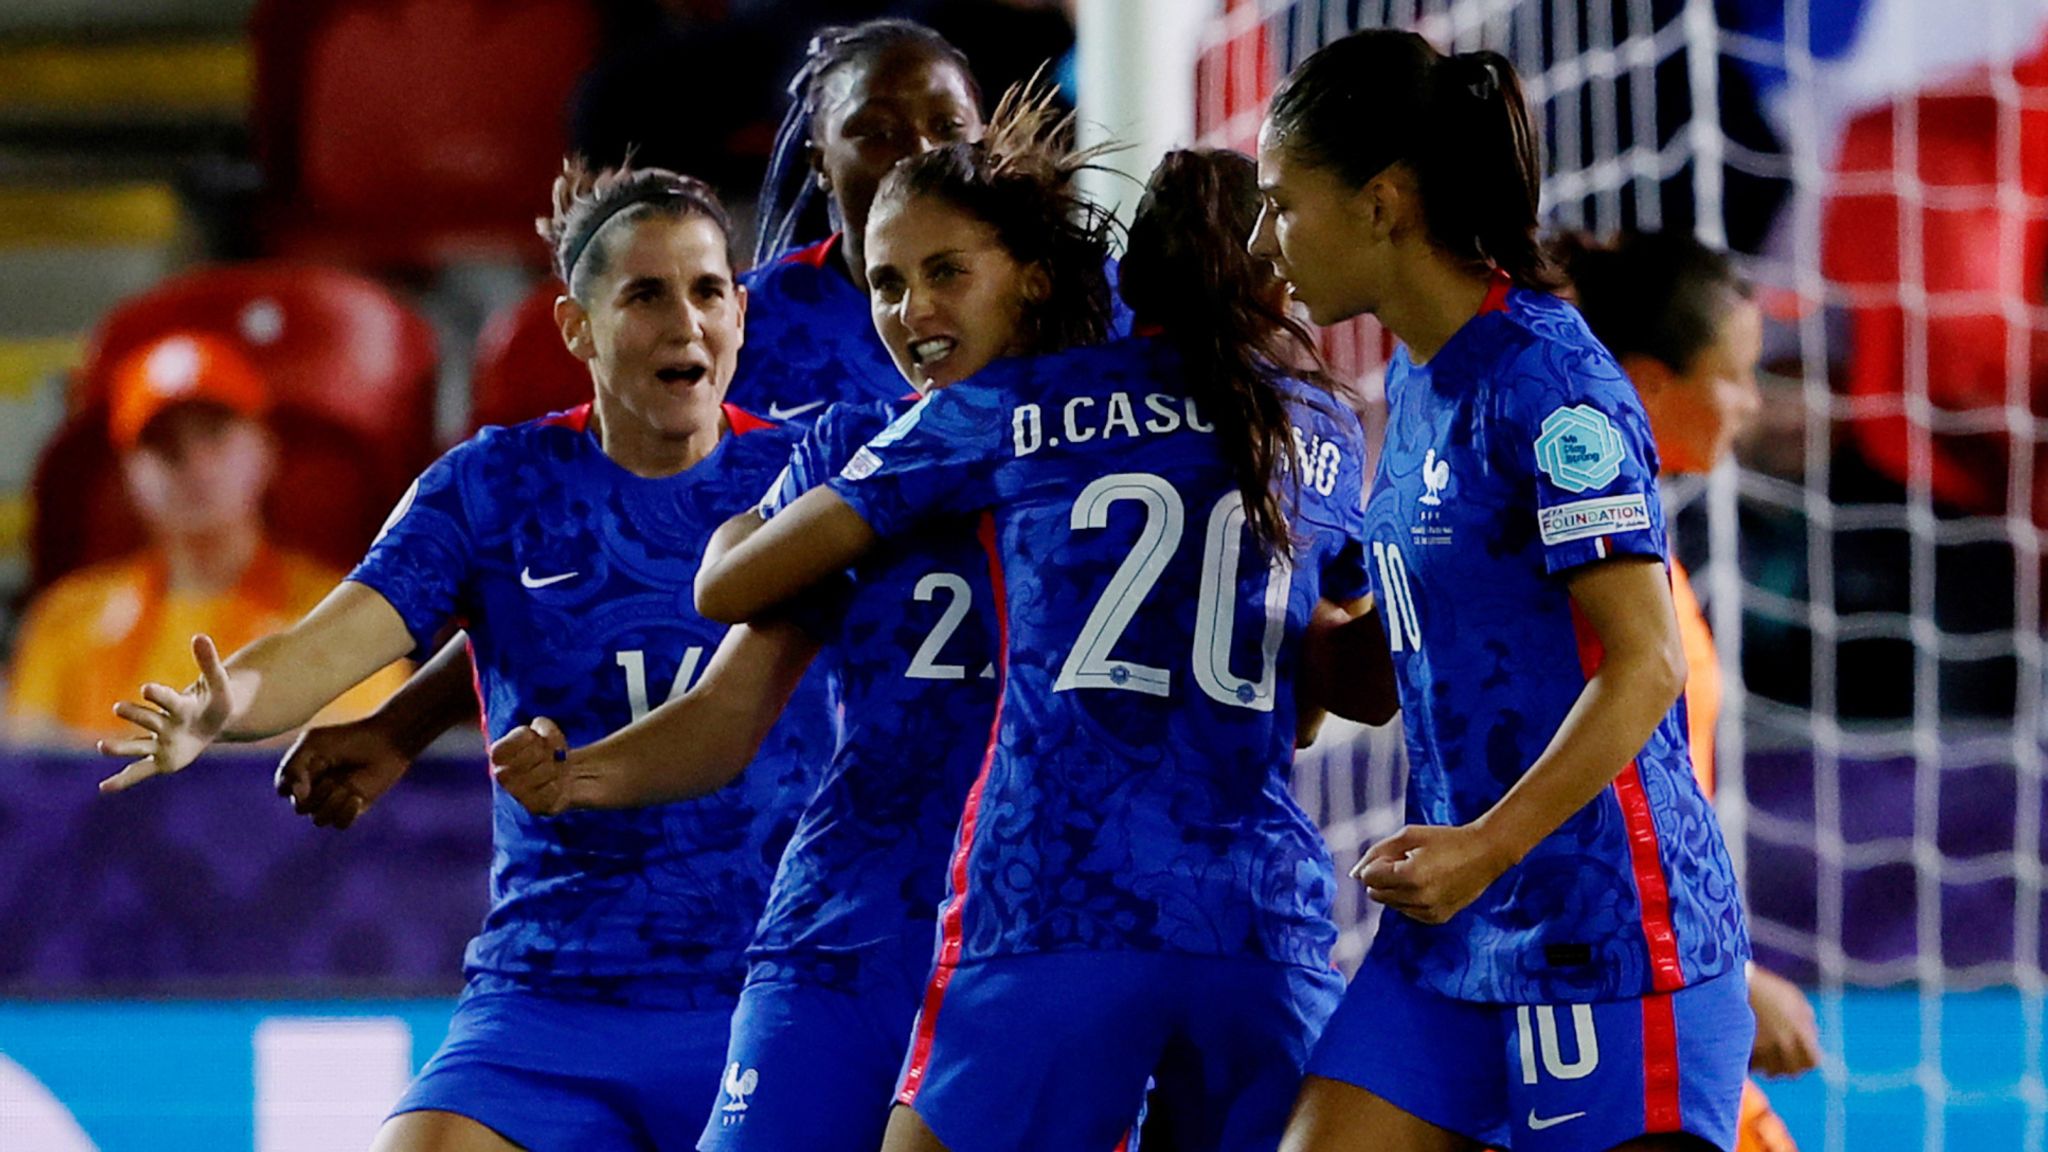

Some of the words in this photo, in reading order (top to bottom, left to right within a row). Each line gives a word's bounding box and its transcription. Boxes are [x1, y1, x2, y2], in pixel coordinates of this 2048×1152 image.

[1542, 505, 1645, 532] FOUNDATION
[905, 572, 996, 679] 2
[1053, 473, 1294, 712] 20
[1372, 541, 1421, 652] 10
[1517, 1003, 1599, 1085] 10
